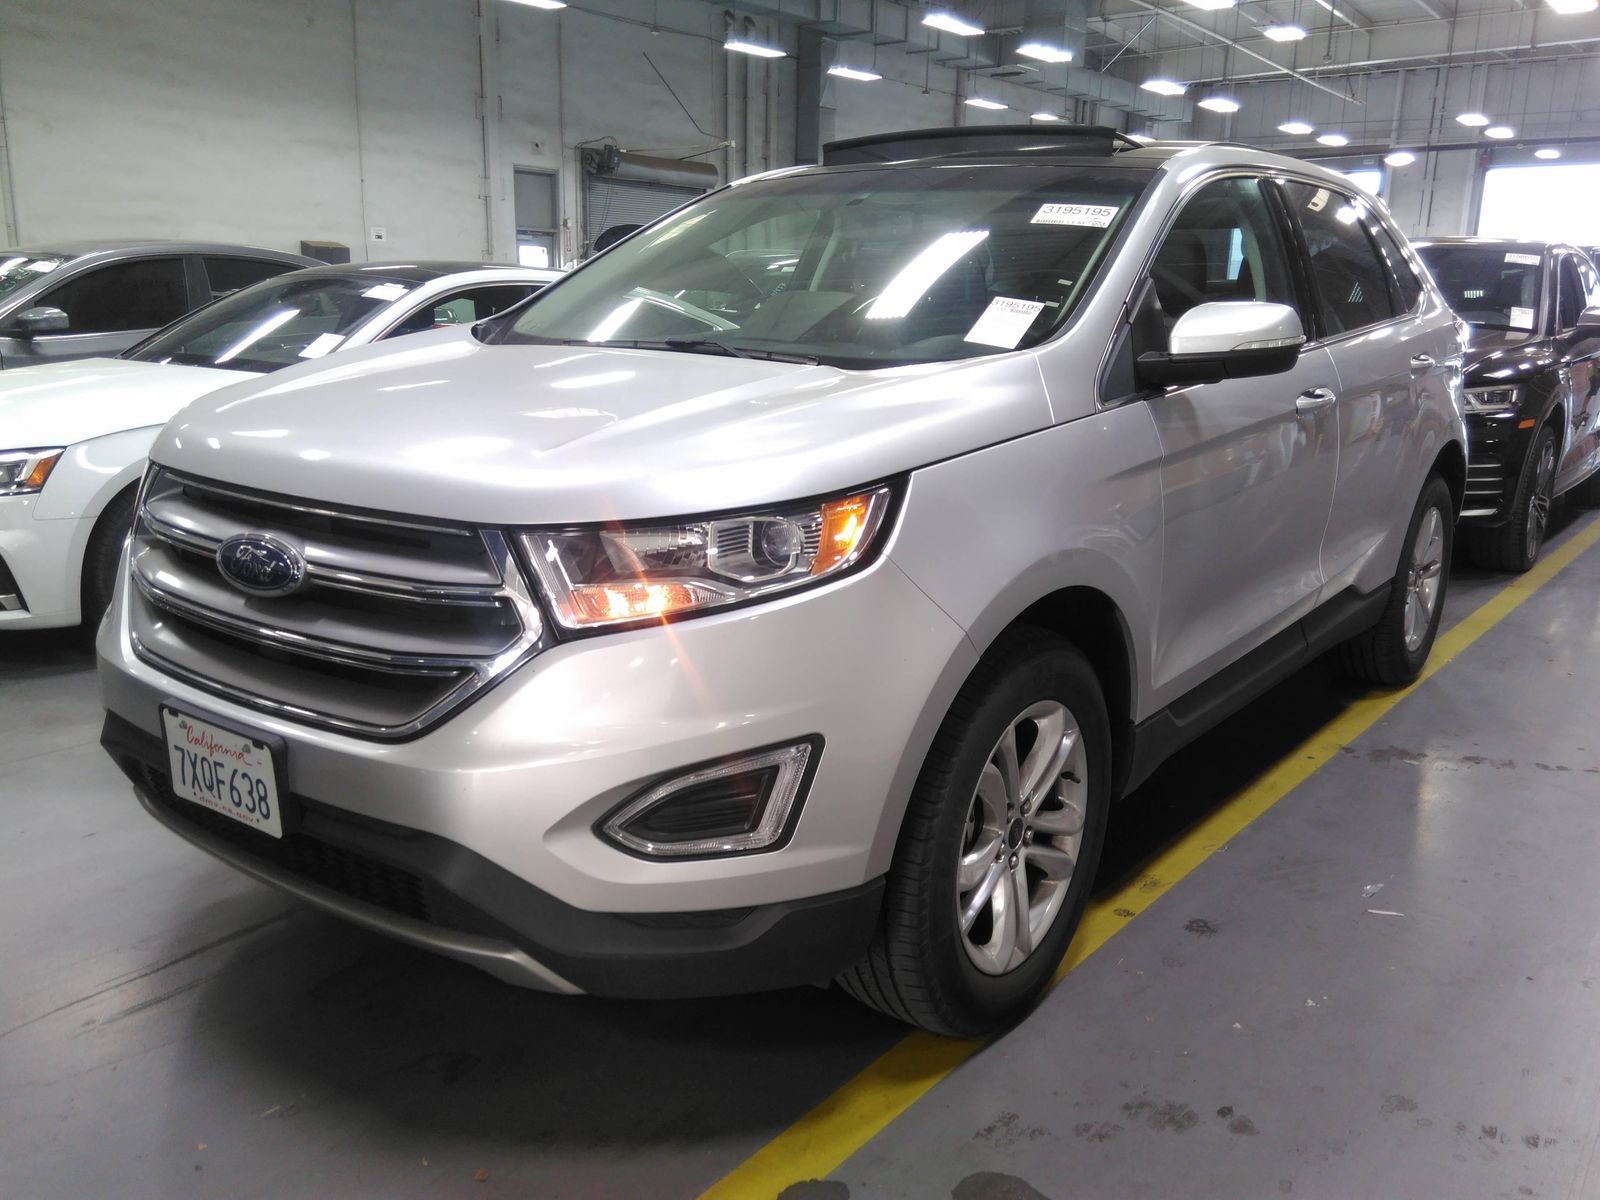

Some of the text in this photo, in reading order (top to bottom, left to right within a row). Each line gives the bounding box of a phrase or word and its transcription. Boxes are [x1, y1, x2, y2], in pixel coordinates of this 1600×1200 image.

[1043, 205, 1112, 217] 3195195
[991, 298, 1041, 312] 3195195
[186, 725, 253, 767] California
[174, 744, 270, 821] 7XQF638
